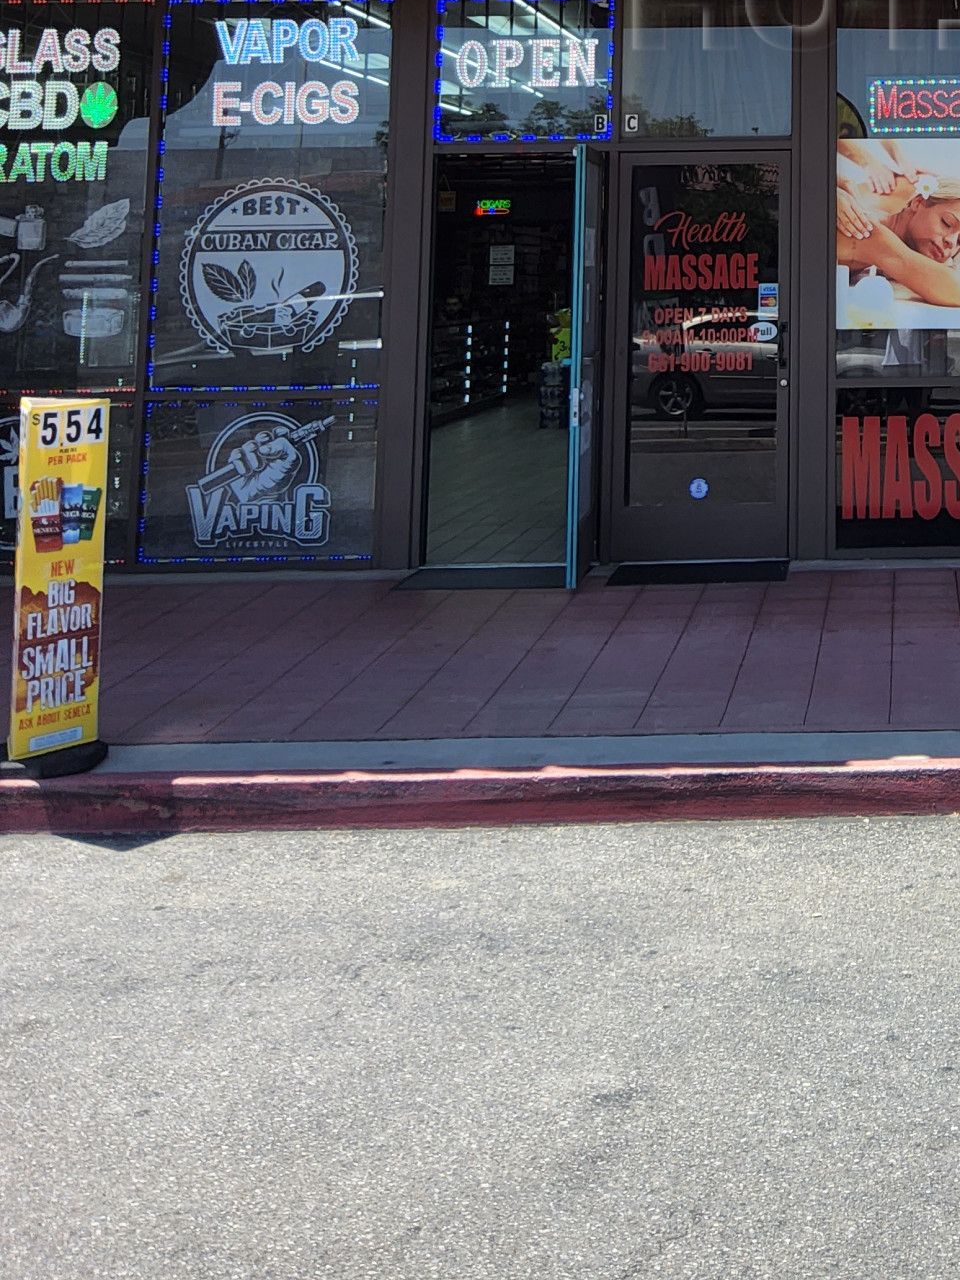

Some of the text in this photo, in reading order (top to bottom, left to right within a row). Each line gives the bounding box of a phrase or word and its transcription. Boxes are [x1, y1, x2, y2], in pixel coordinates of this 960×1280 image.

[215, 17, 360, 65] VAPOR
[455, 37, 600, 89] OPEN
[211, 81, 360, 127] E-CIGS
[596, 116, 605, 130] B
[627, 116, 637, 130] C
[242, 195, 301, 216] BEST
[480, 200, 511, 209] CIGARS
[201, 232, 339, 250] CUBAN CIGAR
[653, 211, 750, 251] Health
[643, 253, 759, 291] MASSAGE
[654, 307, 748, 325] OPEN 7 DAYS
[48, 452, 87, 466] PER PACK
[225, 540, 289, 548] LIFESTYLE
[50, 559, 75, 578] NEW
[47, 578, 76, 608] BIG
[26, 603, 92, 641] FLAVOR
[22, 635, 93, 680] SMALL
[26, 669, 87, 713] PRICE
[18, 718, 33, 730] ASK
[36, 712, 61, 727] ABOUT
